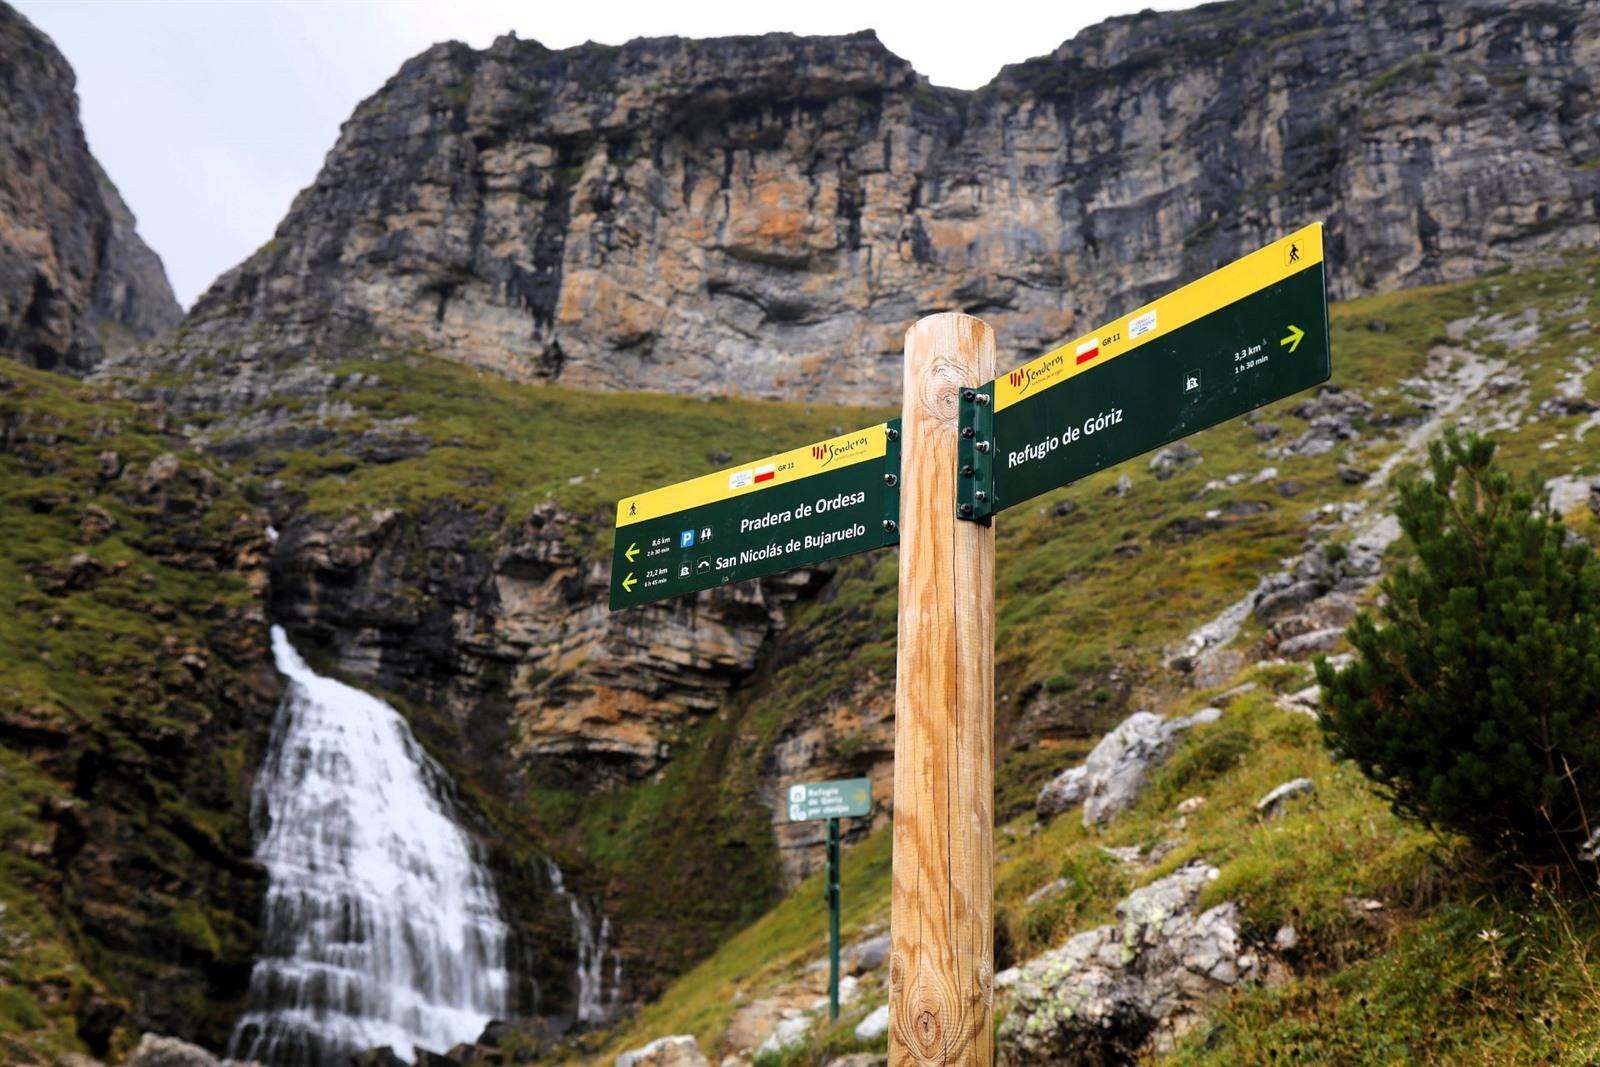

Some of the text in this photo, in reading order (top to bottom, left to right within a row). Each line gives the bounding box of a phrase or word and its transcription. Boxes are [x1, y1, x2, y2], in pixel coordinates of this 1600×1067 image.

[1102, 333, 1121, 346] GR 11
[1234, 344, 1261, 362] 3,3 km
[1019, 355, 1064, 394] Senderos
[1246, 360, 1255, 369] 30
[1255, 355, 1269, 365] min
[821, 436, 868, 467] Senderos
[1008, 408, 1123, 468] Refugio de Góriz
[740, 491, 865, 533] Pradera de Ordesa
[715, 523, 866, 571] San Nicolás de Bujaruelo
